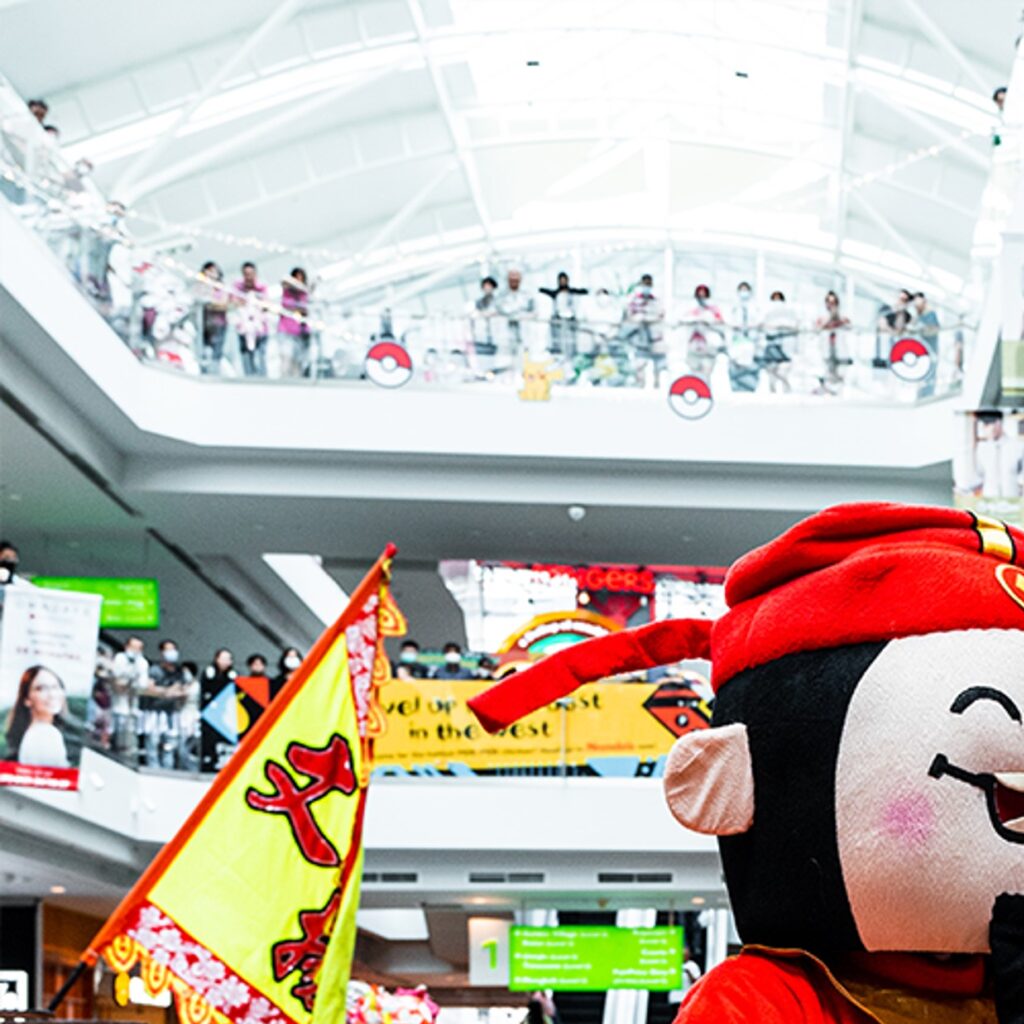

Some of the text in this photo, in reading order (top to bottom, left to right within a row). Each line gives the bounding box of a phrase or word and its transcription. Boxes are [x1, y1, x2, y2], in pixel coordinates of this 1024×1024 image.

[408, 722, 428, 740] in
[437, 720, 479, 741] the
[481, 938, 499, 970] 1
